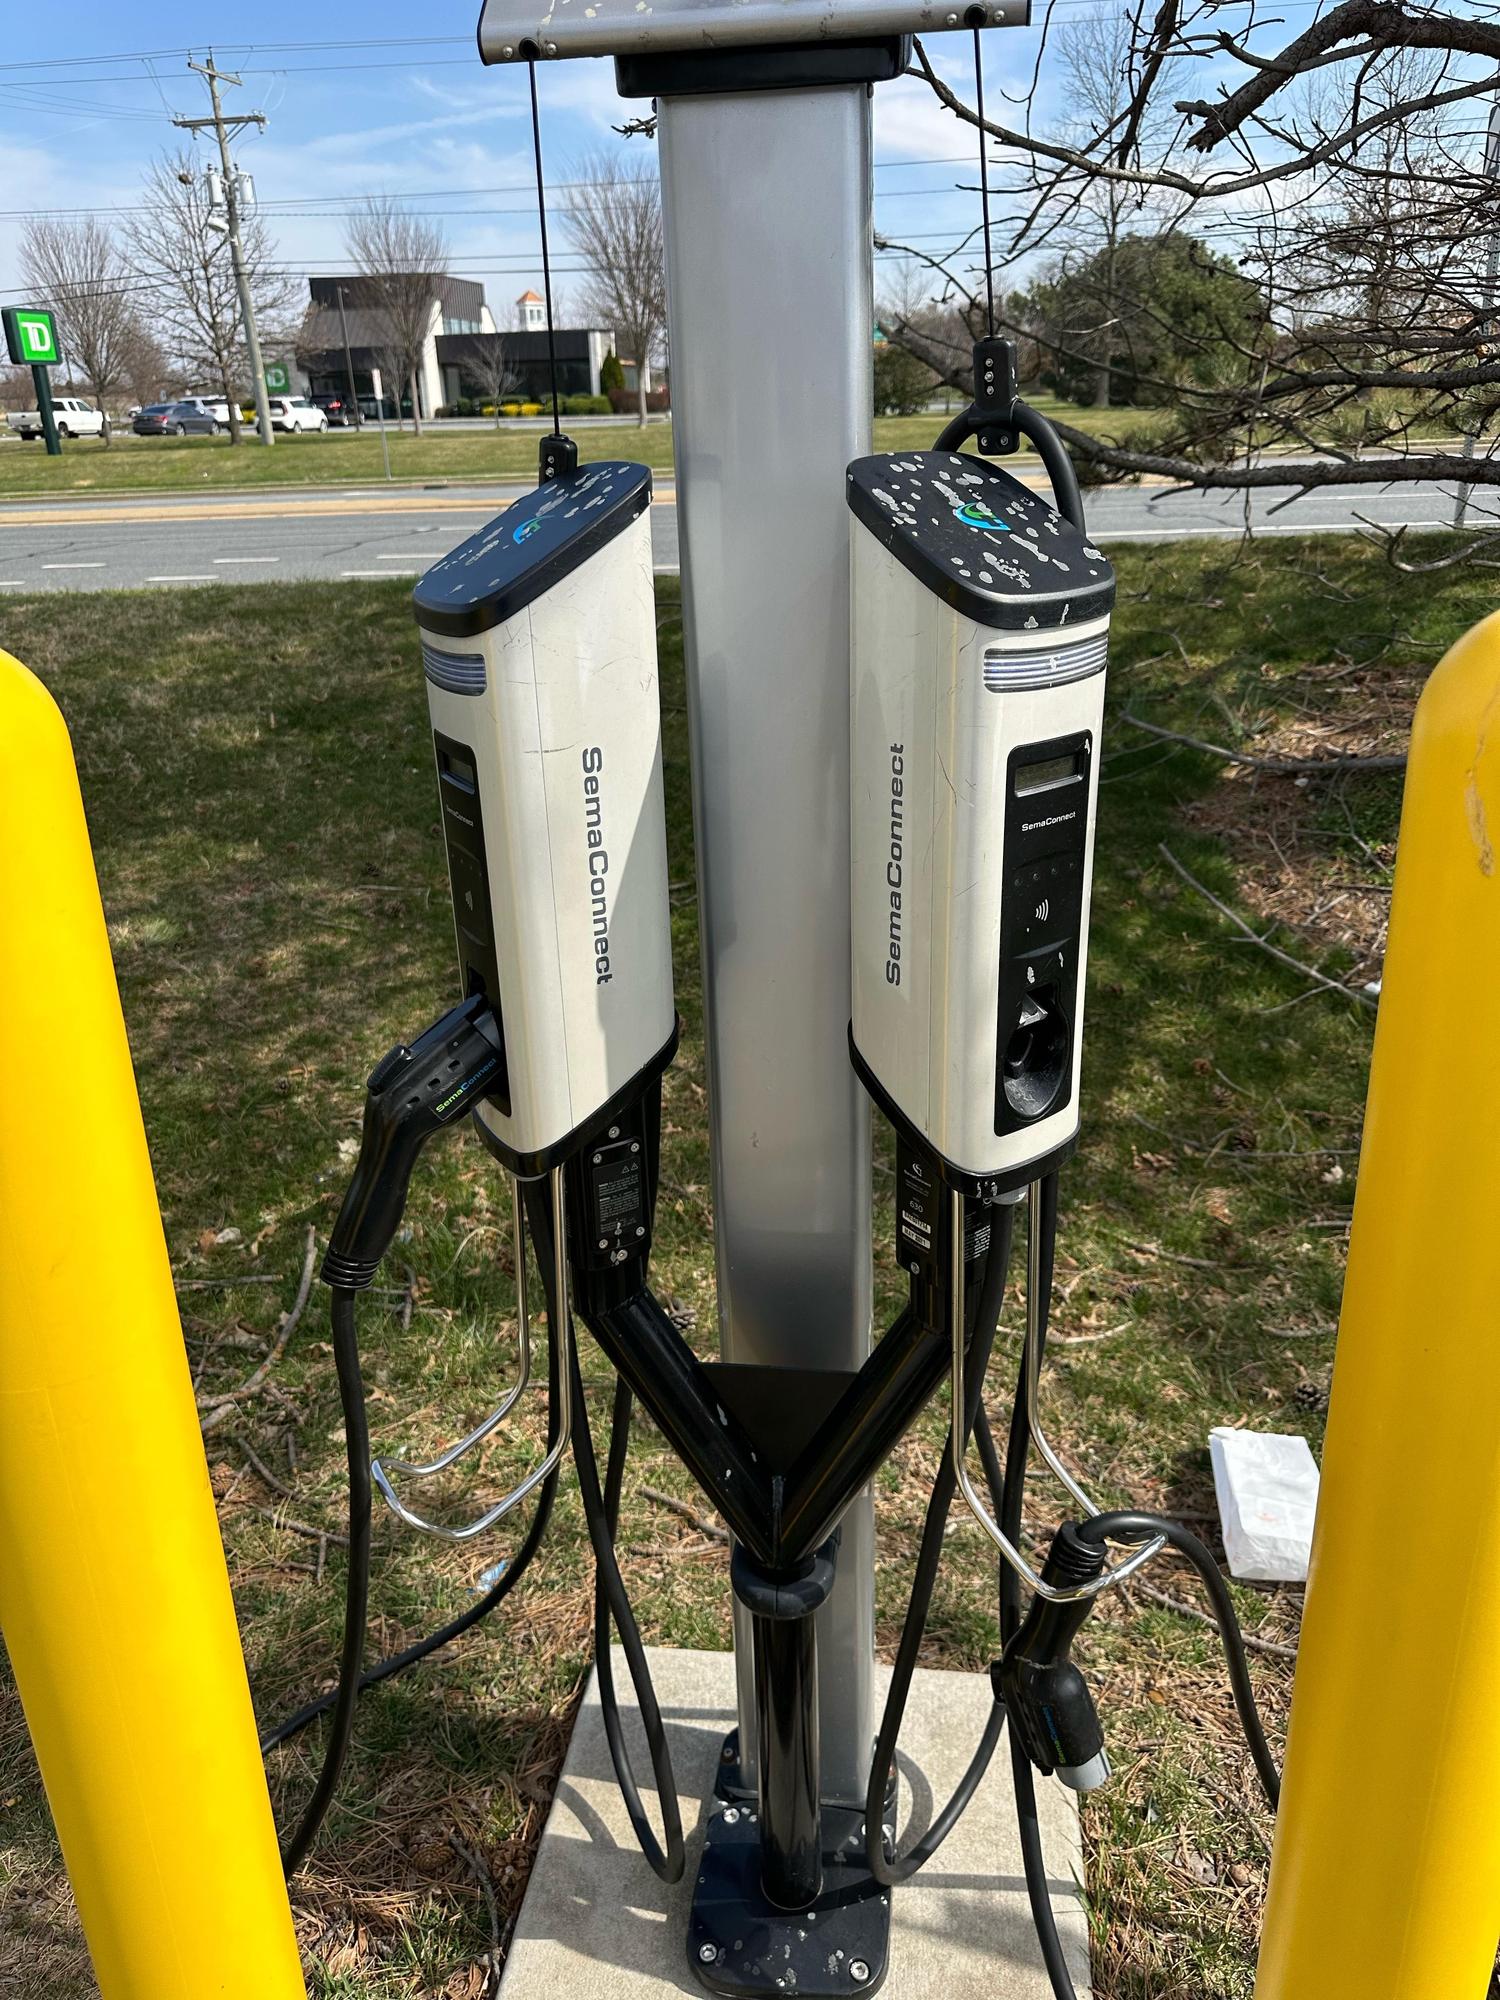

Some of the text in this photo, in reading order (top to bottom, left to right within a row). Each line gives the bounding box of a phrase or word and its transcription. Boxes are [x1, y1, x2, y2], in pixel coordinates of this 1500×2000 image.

[20, 321, 51, 352] TD
[1021, 811, 1076, 832] SemaConnect
[582, 746, 613, 985] SemaConnect
[886, 743, 905, 987] SemaConnect
[435, 1058, 497, 1113] SemaConnect
